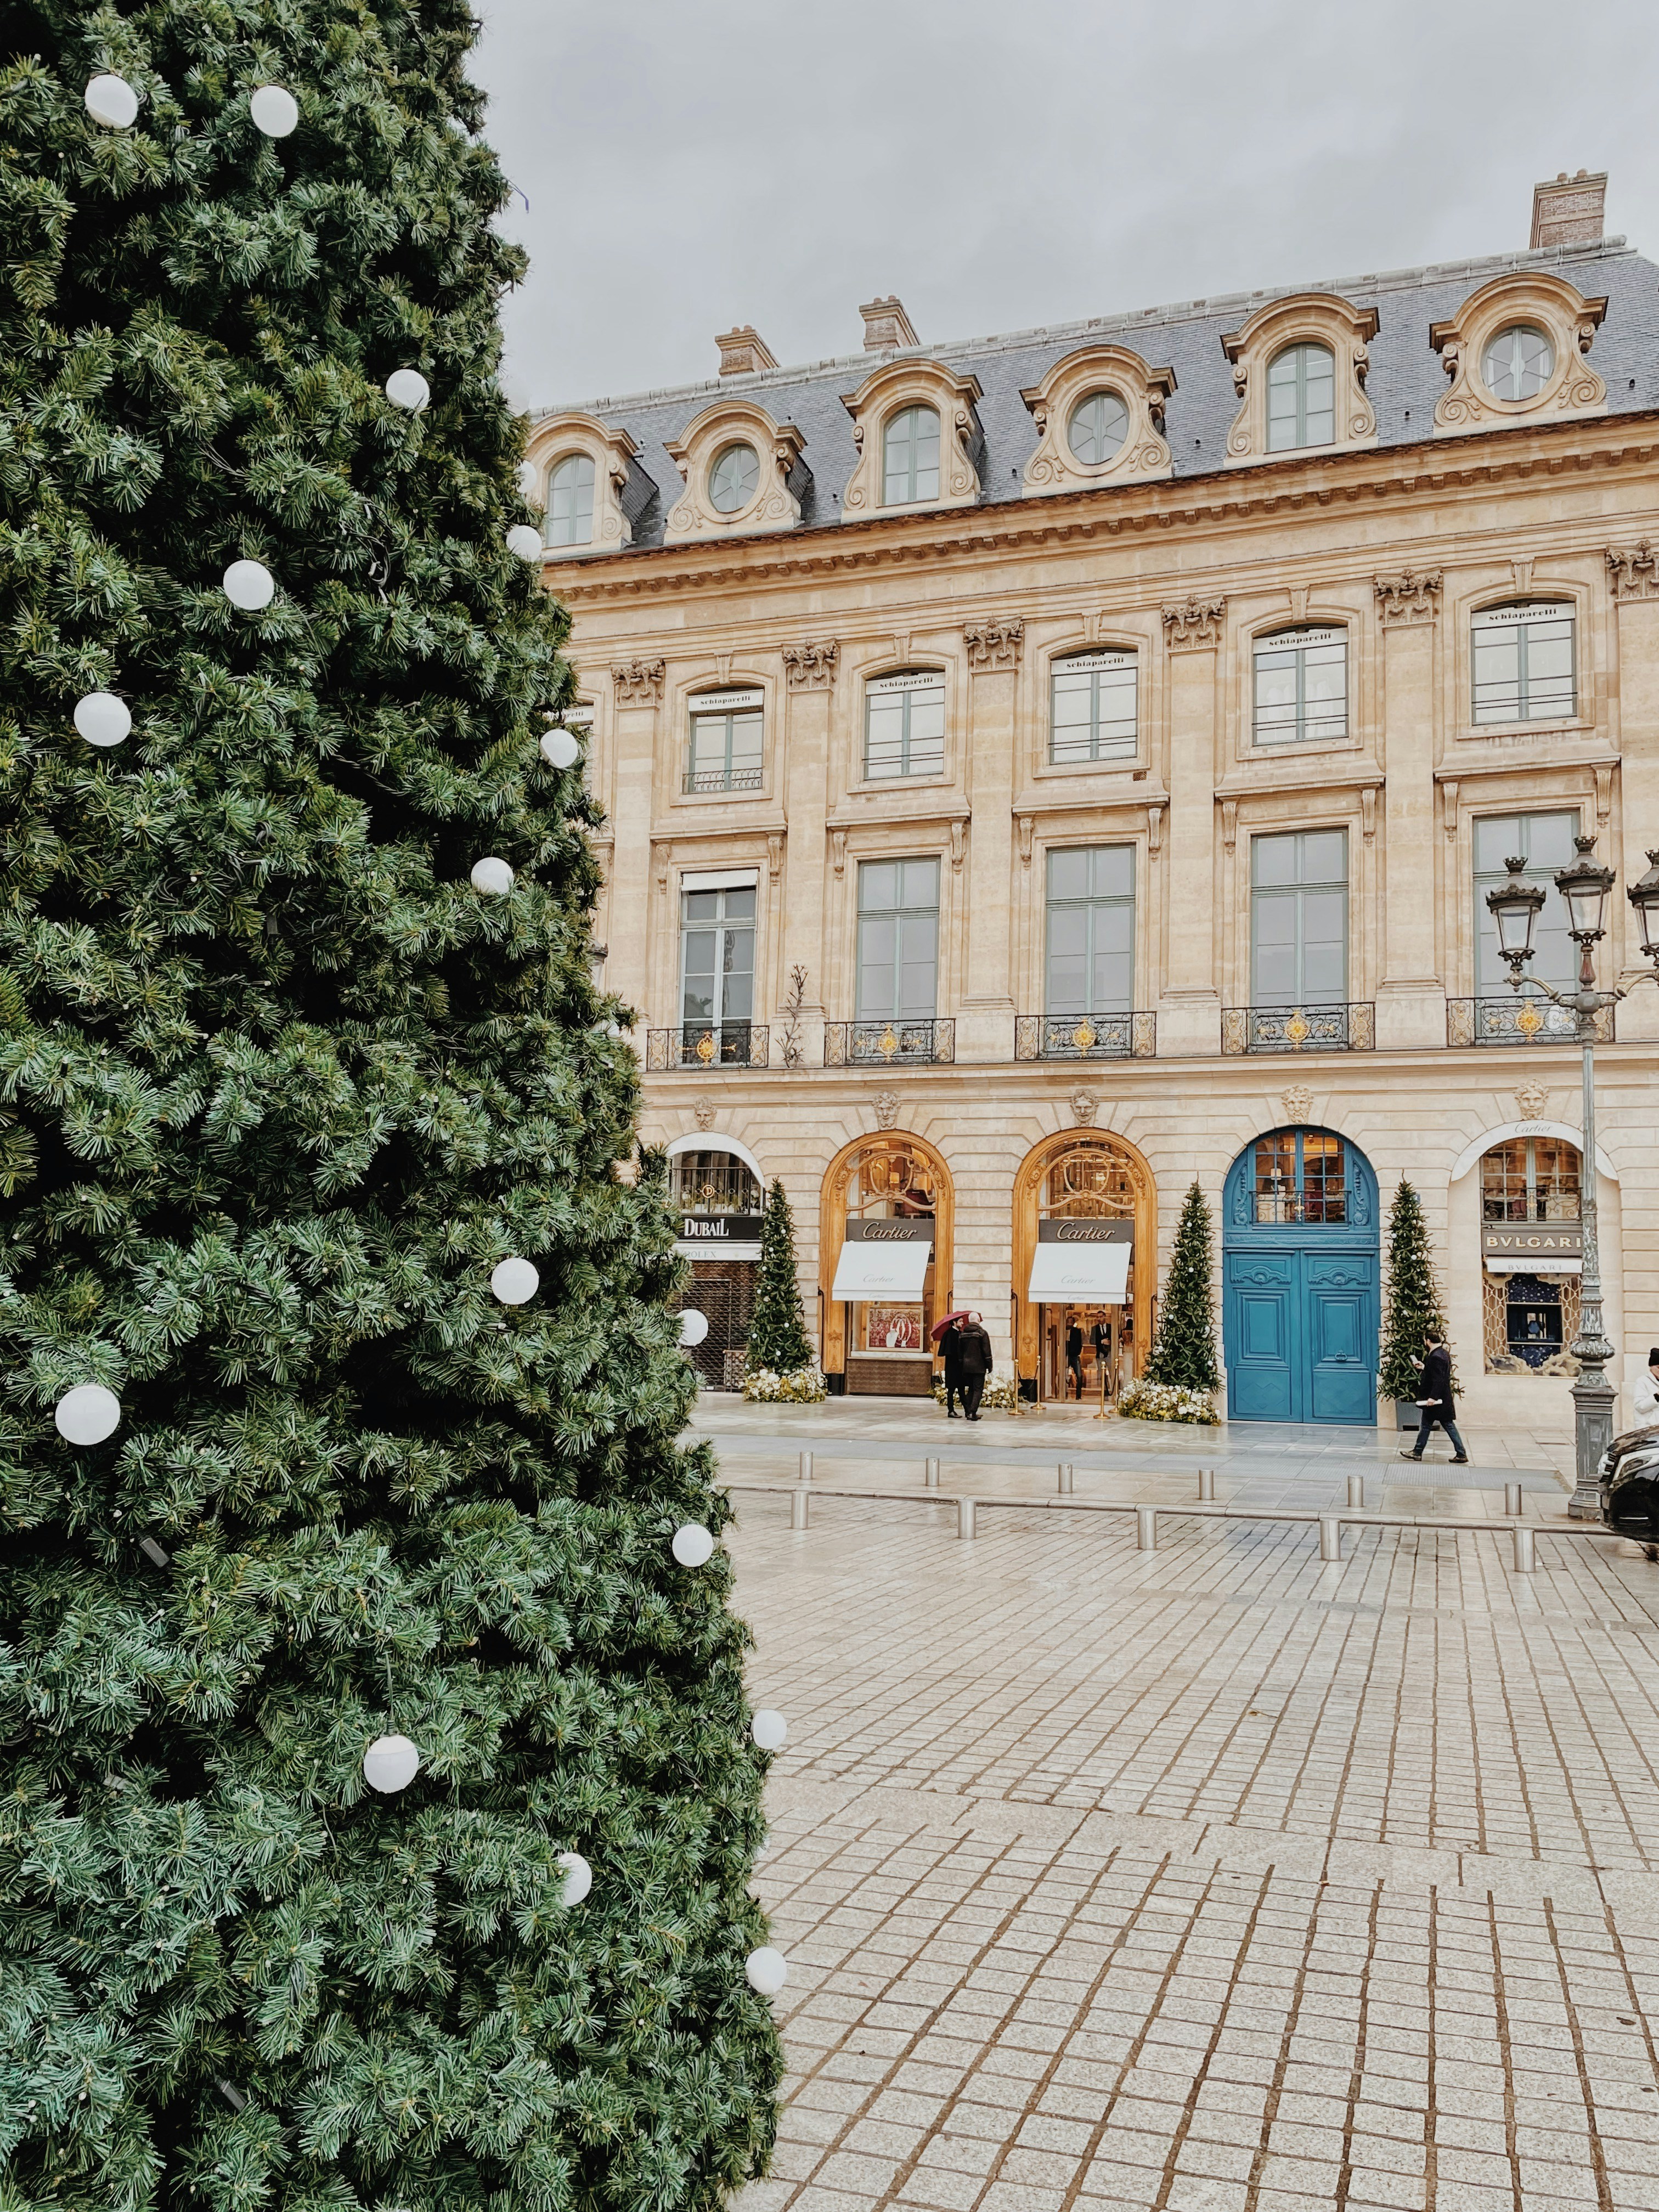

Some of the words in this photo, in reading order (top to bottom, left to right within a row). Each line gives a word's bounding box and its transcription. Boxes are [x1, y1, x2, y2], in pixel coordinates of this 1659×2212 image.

[1489, 608, 1556, 620] schiaparelli
[1269, 633, 1331, 646] schiaparelli
[1066, 657, 1124, 668] schiaparelli
[879, 677, 933, 687] schiaparelli
[701, 696, 750, 705] schiaparelli
[1515, 1122, 1553, 1133] Cartier
[862, 1222, 917, 1239] Cartier
[1057, 1222, 1115, 1240] Cartier
[1486, 1237, 1582, 1248] BVLGARI
[863, 1274, 895, 1283] Cartier
[1061, 1274, 1096, 1284] Cartier
